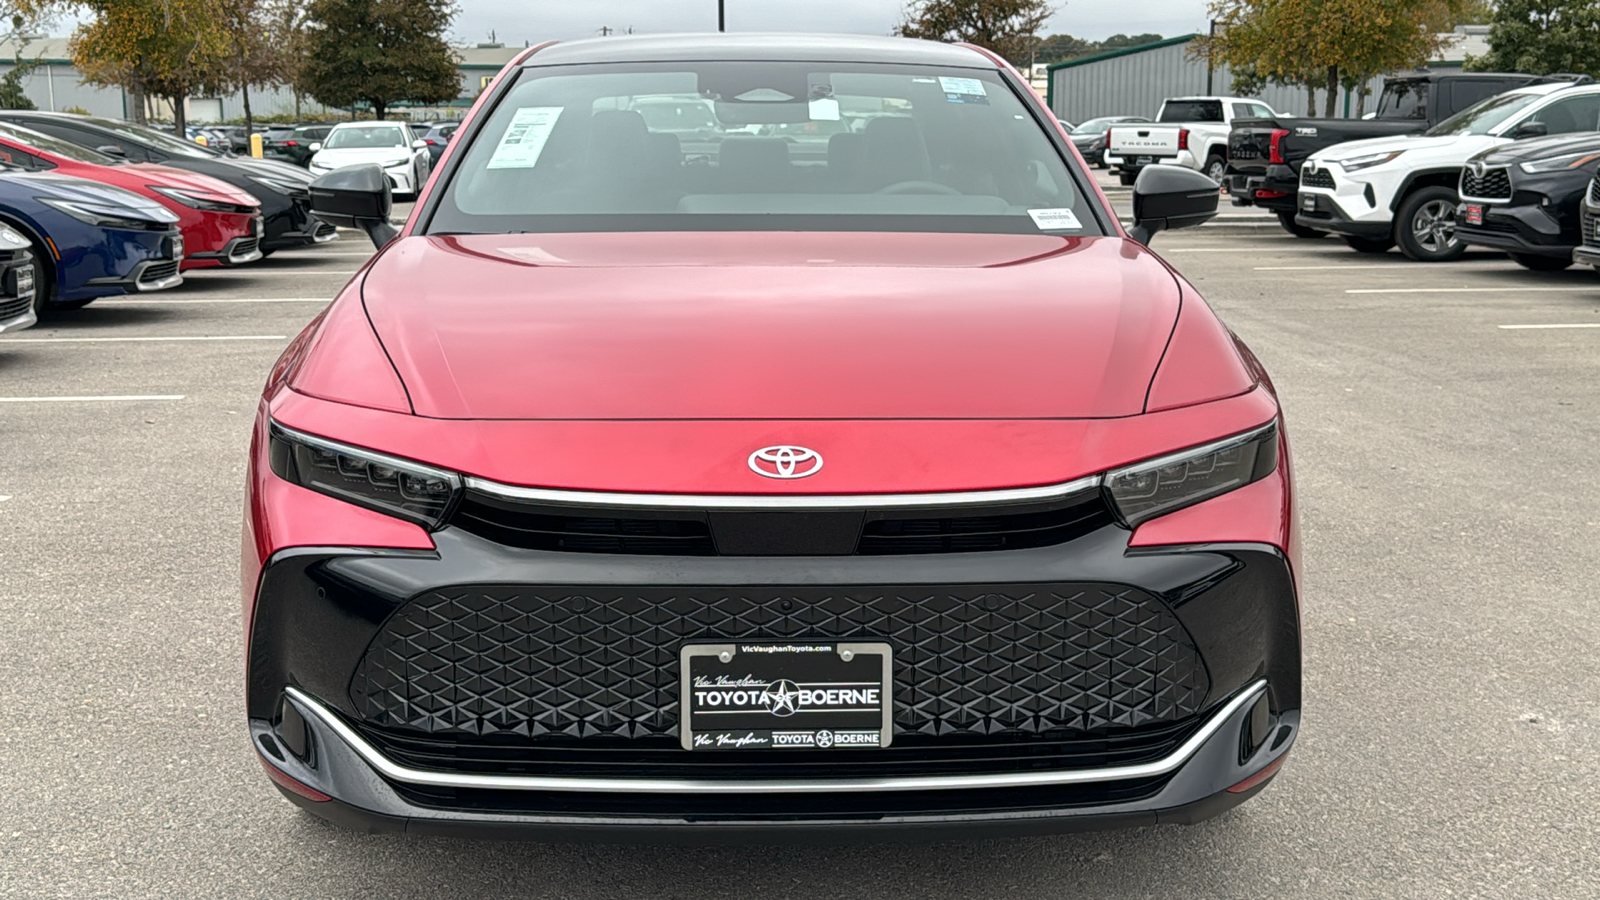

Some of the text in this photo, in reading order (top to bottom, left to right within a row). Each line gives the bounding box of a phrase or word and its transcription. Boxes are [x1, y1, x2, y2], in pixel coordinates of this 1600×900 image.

[741, 645, 832, 654] VicVaughanToyota.com
[693, 673, 767, 688] Vic Vaughan
[694, 690, 771, 706] TOYOTA
[798, 689, 880, 705] BOERNE
[694, 733, 714, 746] Vic
[716, 731, 769, 748] Vaughan
[772, 734, 815, 744] TOYOTA
[834, 734, 880, 743] BOERNE
